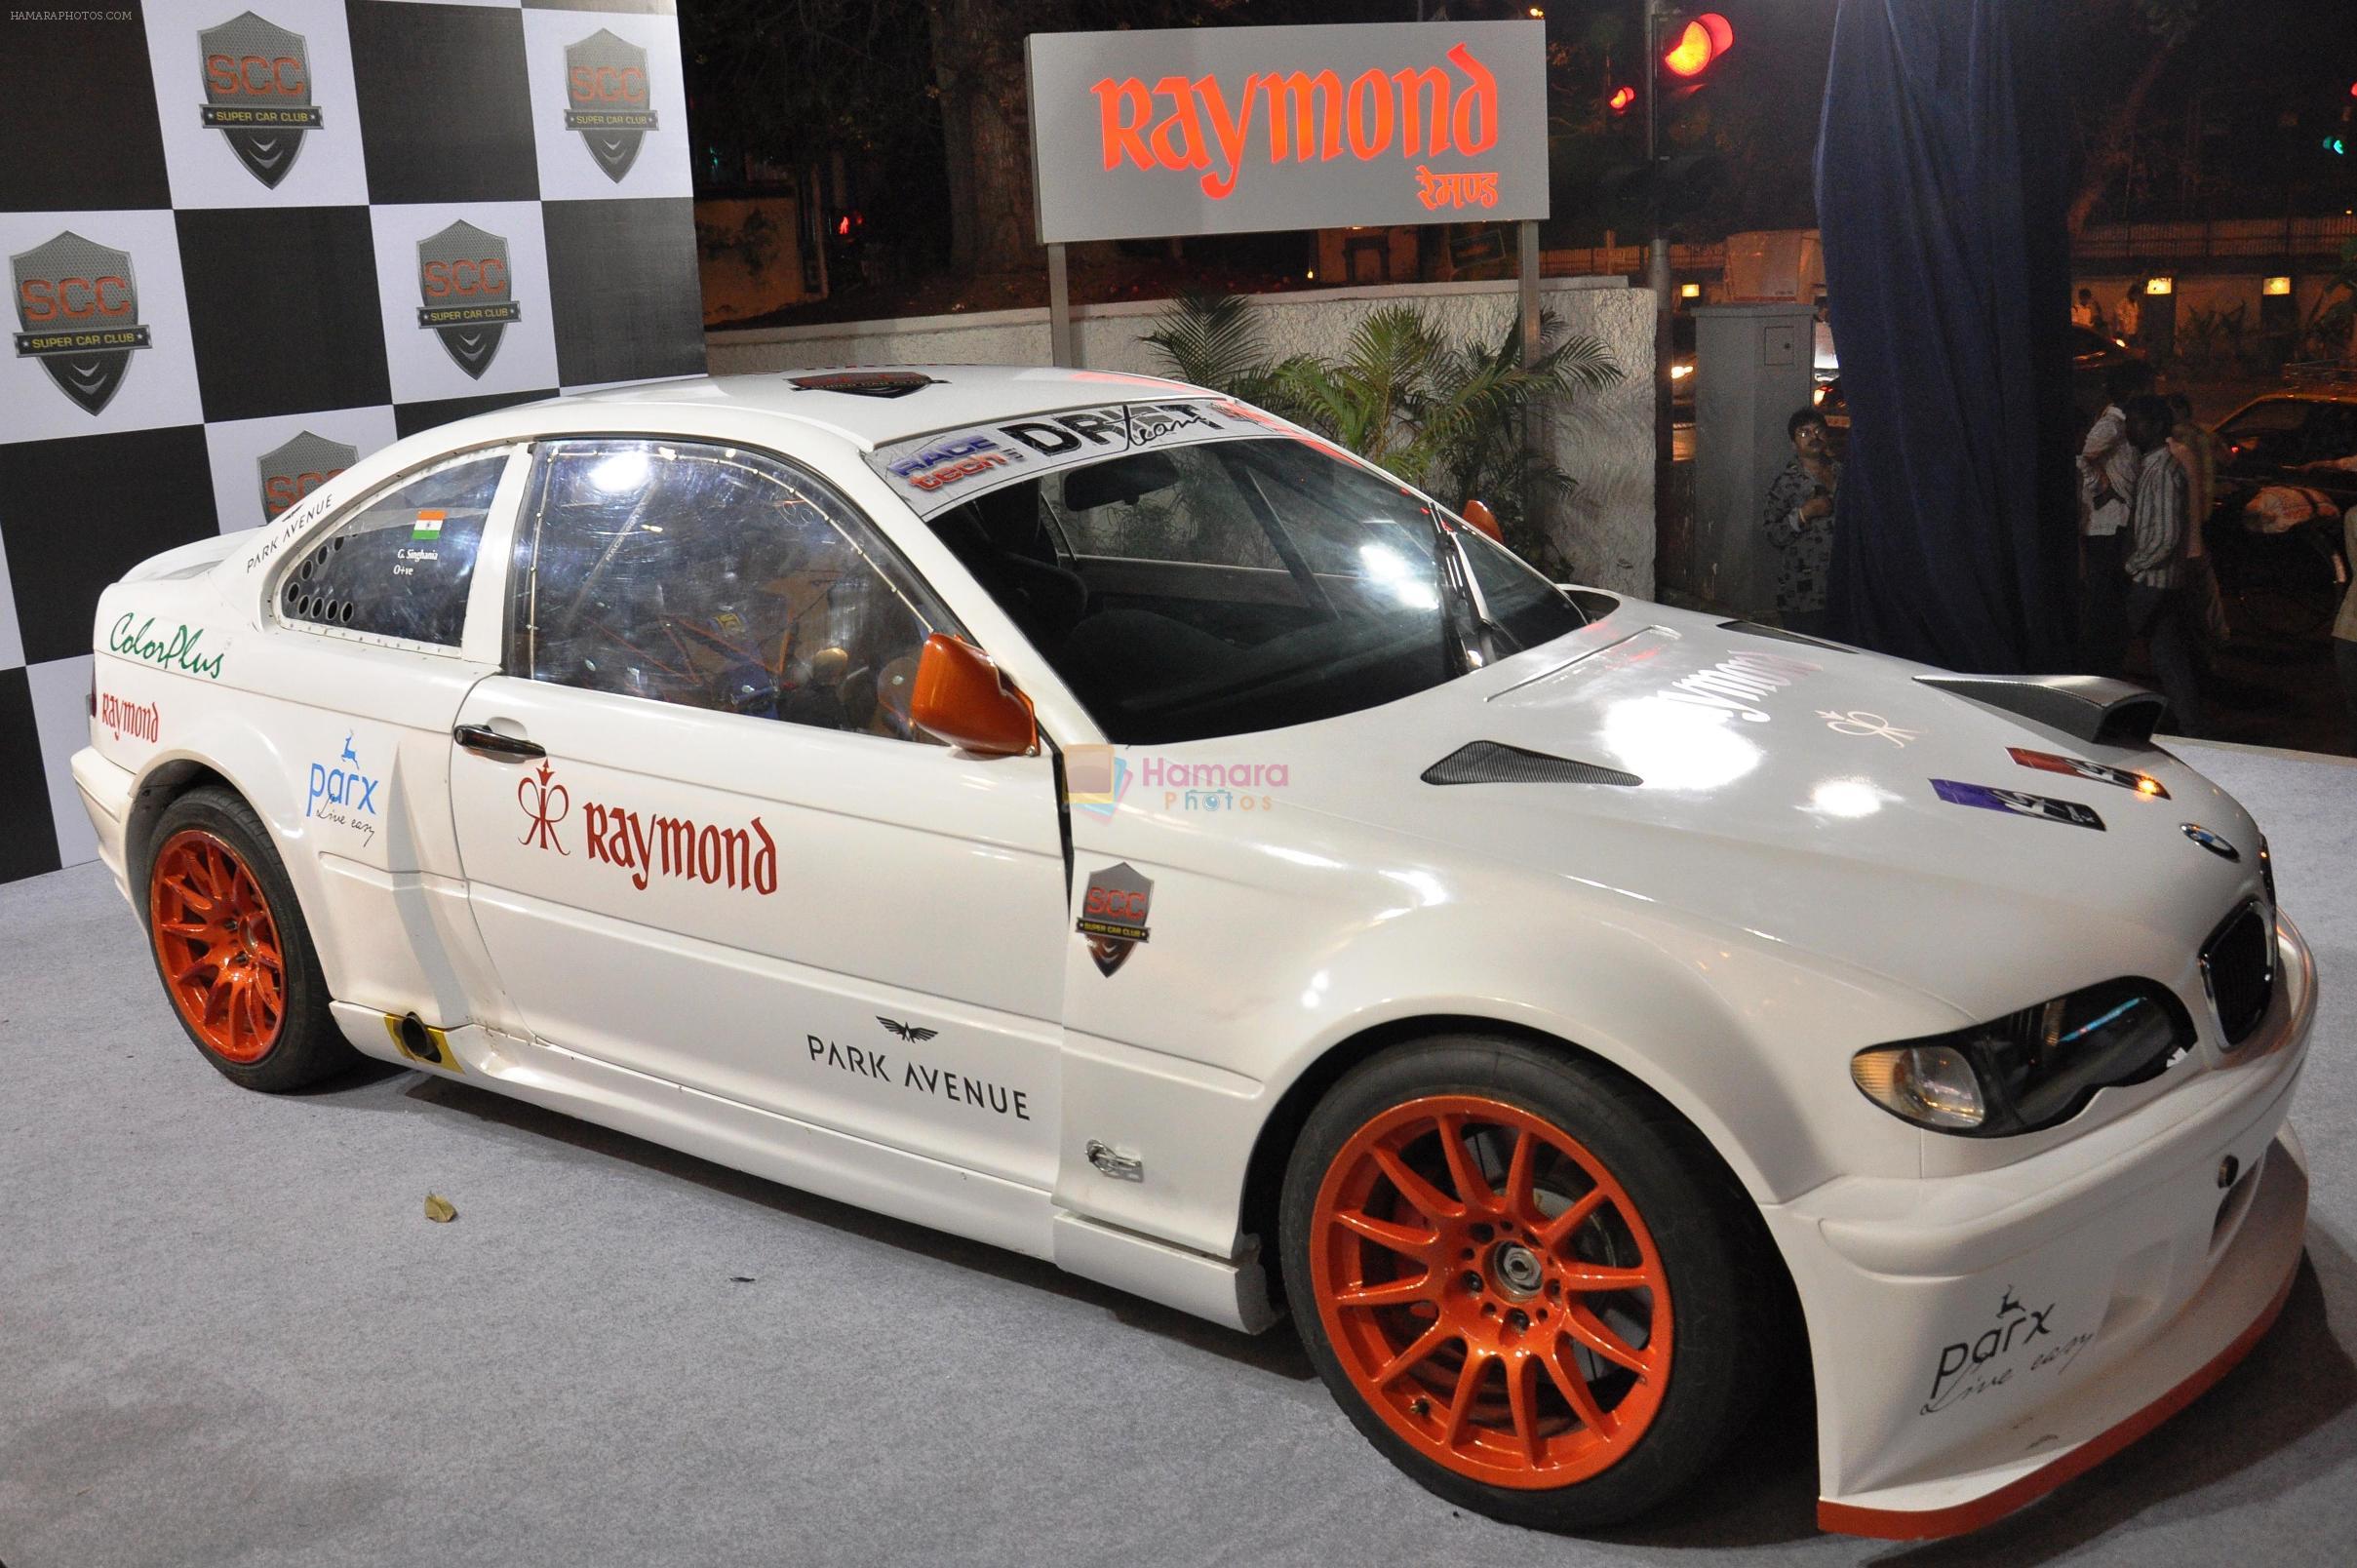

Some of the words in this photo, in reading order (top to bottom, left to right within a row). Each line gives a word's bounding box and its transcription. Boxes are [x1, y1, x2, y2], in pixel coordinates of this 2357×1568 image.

[207, 54, 304, 95] SCC
[570, 66, 646, 102] SCC
[216, 112, 253, 122] SUPER
[255, 113, 278, 122] CAR
[281, 113, 308, 122] CLUB
[576, 115, 604, 124] SUPER
[1090, 42, 1499, 199] Raymond
[21, 276, 131, 321] SCC
[424, 258, 506, 296] SCC
[430, 310, 461, 321] SUPER
[463, 309, 483, 319] CAR
[485, 307, 508, 317] CLUB
[31, 336, 72, 349] SUPER
[76, 335, 101, 346] CAR
[103, 333, 135, 344] CLUB
[887, 435, 999, 477] RACE
[265, 468, 346, 514] SC
[247, 538, 279, 573] PARK
[283, 493, 333, 542] AVENUE
[110, 612, 224, 679] ColorPlus
[101, 692, 159, 743] Raymond
[306, 764, 378, 817] parx
[582, 802, 777, 895] Raymond
[1085, 886, 1145, 921] SCC
[807, 1035, 890, 1082] PARK
[905, 1062, 1030, 1120] AVENUE
[1930, 1303, 2055, 1399] parx
